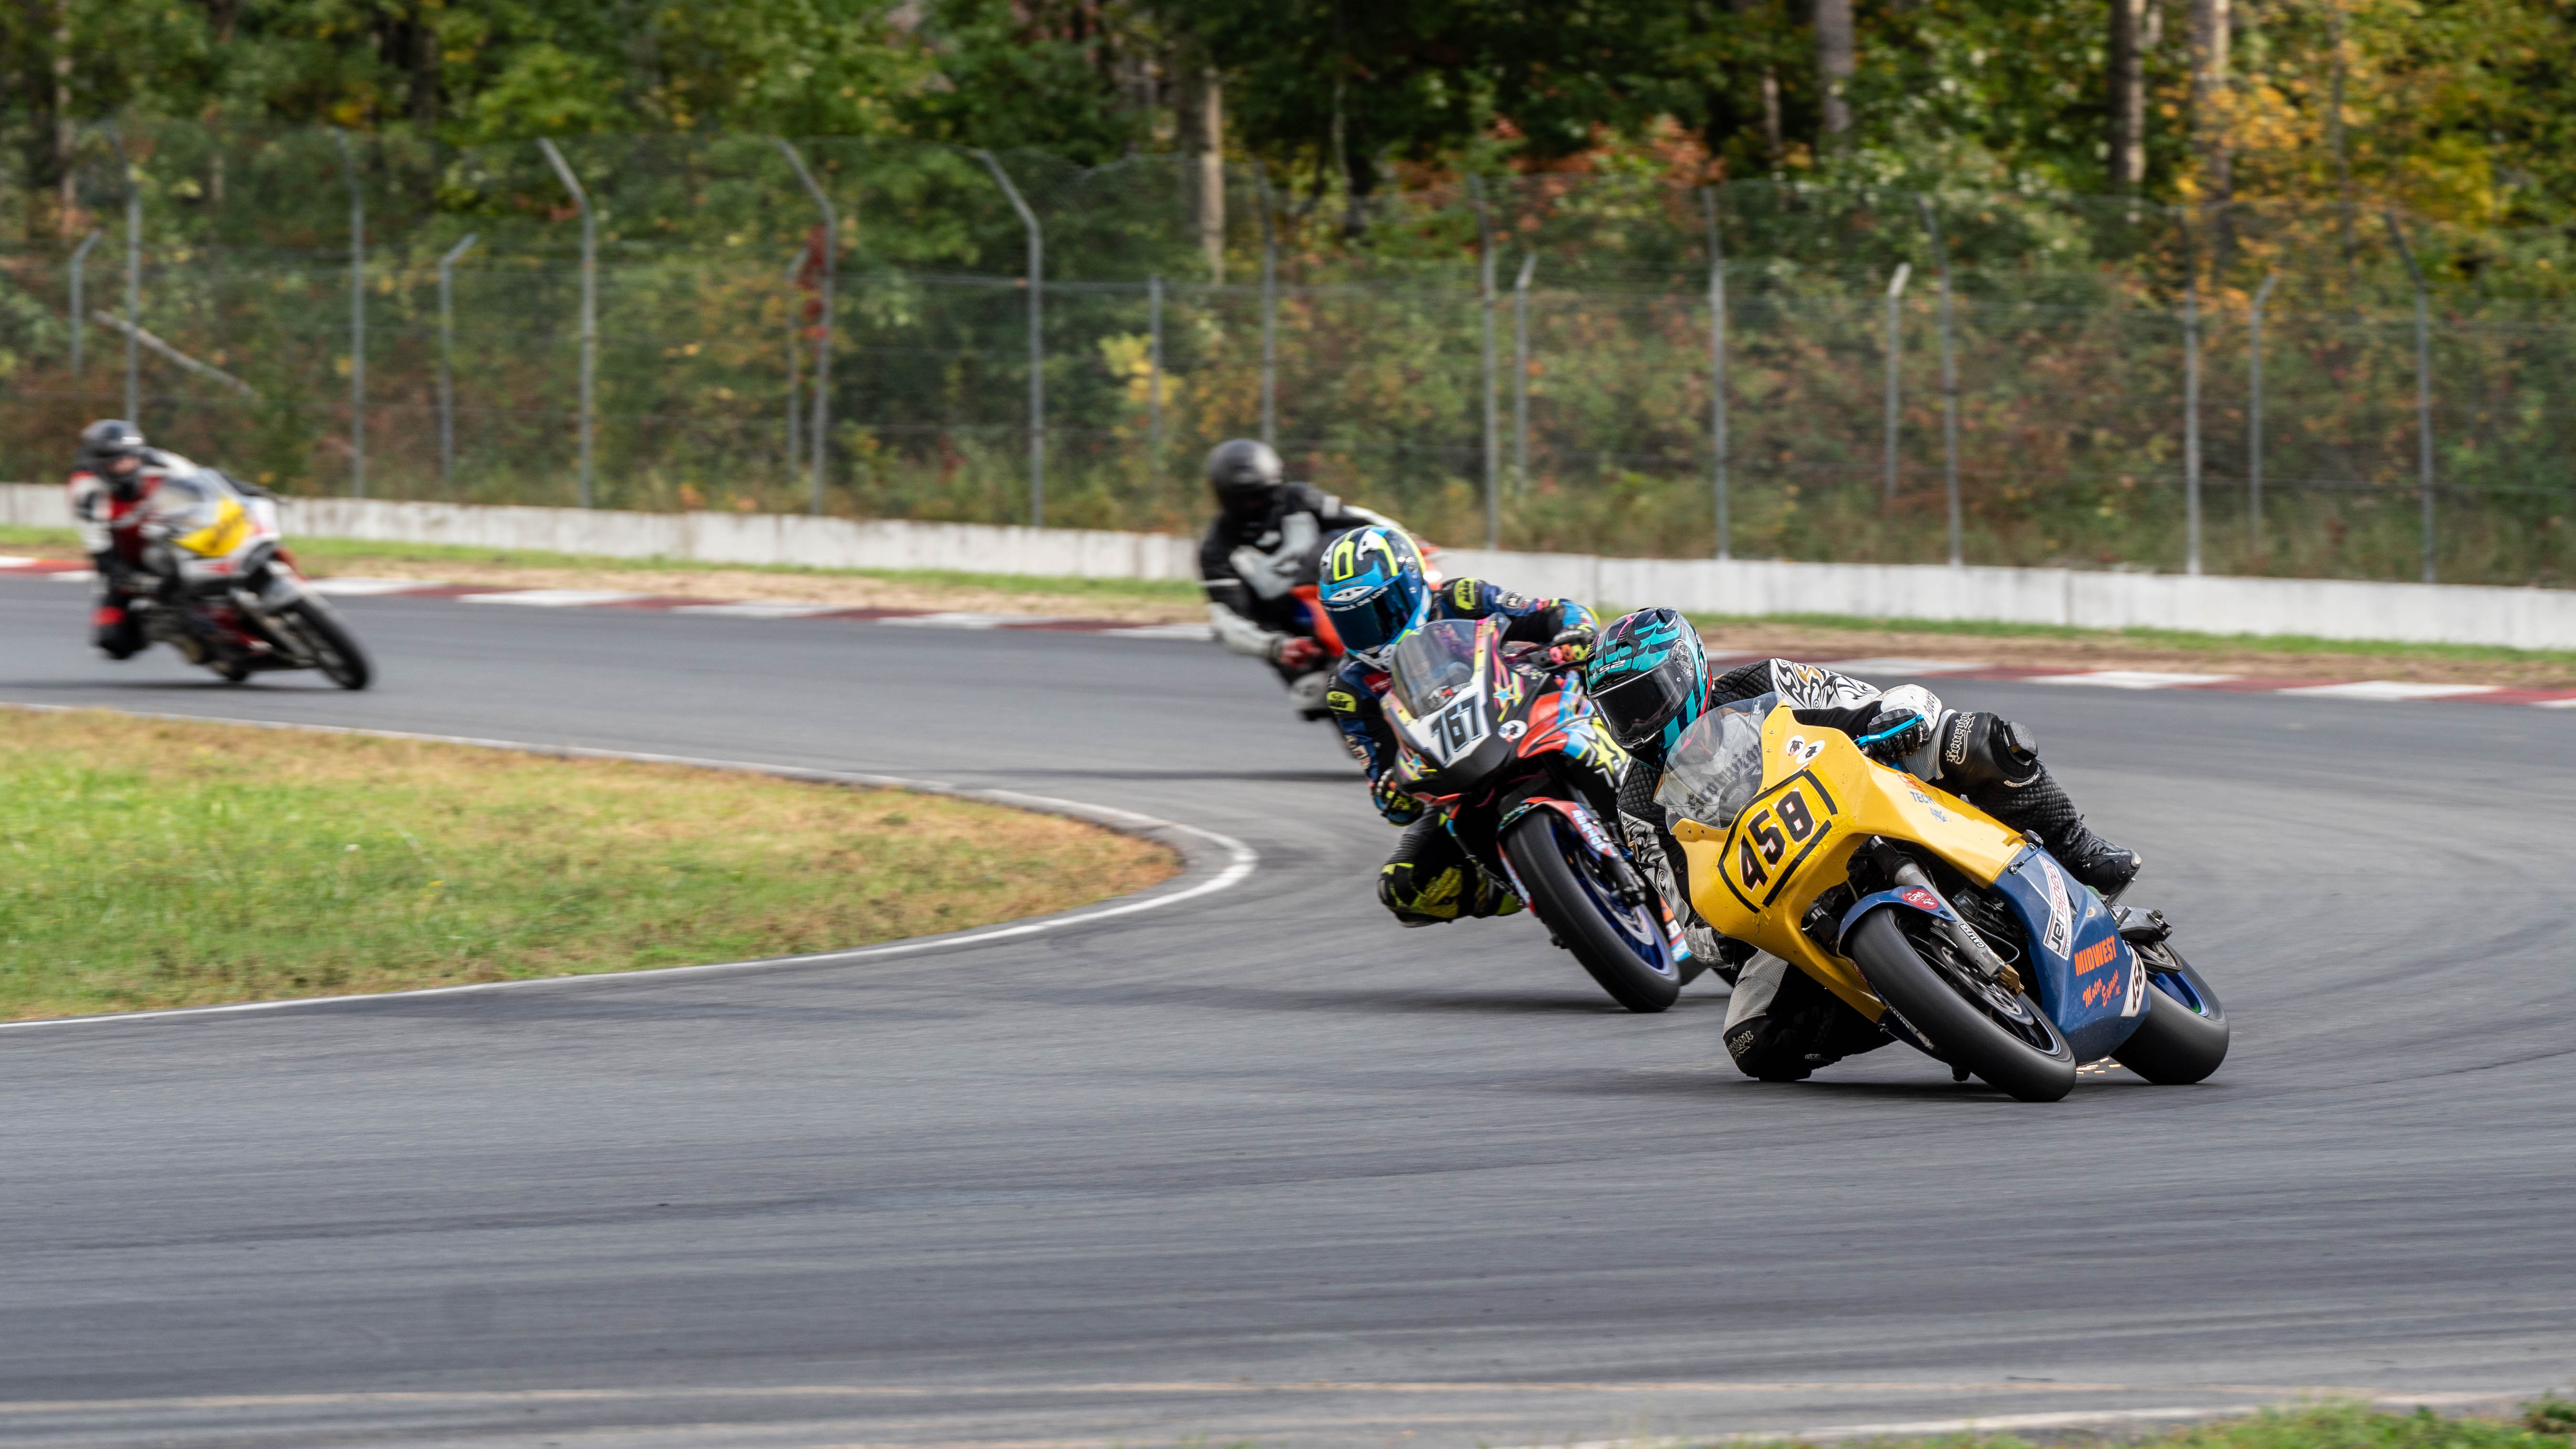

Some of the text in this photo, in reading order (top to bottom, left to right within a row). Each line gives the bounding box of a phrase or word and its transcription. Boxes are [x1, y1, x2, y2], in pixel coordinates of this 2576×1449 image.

[1592, 659, 1626, 679] LS2
[1430, 692, 1483, 763] 767
[1910, 791, 1935, 805] TECH
[1739, 787, 1816, 892] 458
[1908, 891, 1925, 901] CRA
[2074, 934, 2117, 976] MIDWEST
[2082, 978, 2102, 1008] Motor
